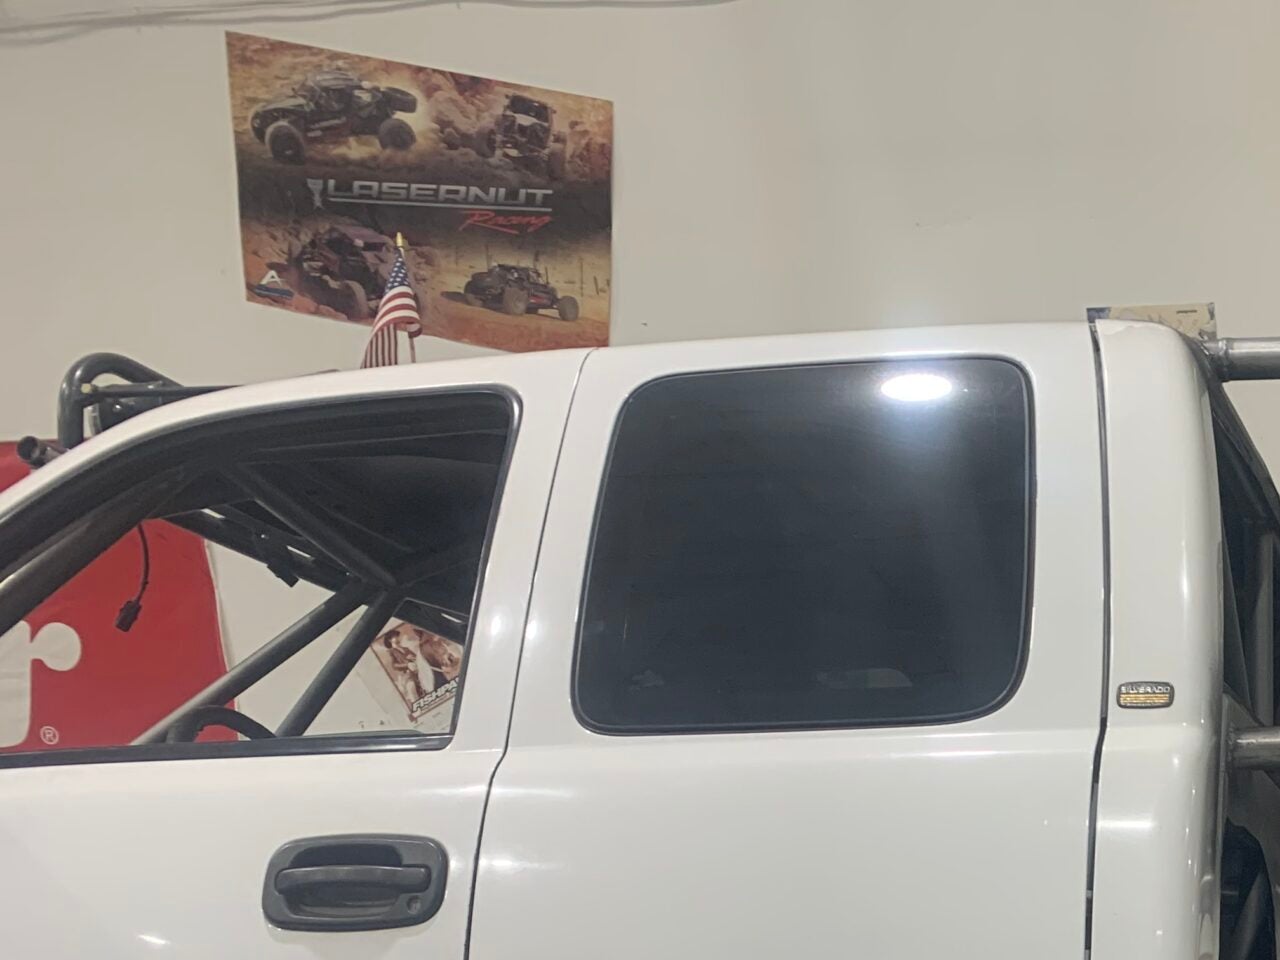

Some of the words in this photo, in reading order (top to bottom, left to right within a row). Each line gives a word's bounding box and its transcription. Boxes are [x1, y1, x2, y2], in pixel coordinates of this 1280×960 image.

[327, 179, 553, 206] LASERNUT
[459, 210, 553, 234] Racing
[412, 676, 459, 712] FISHPA
